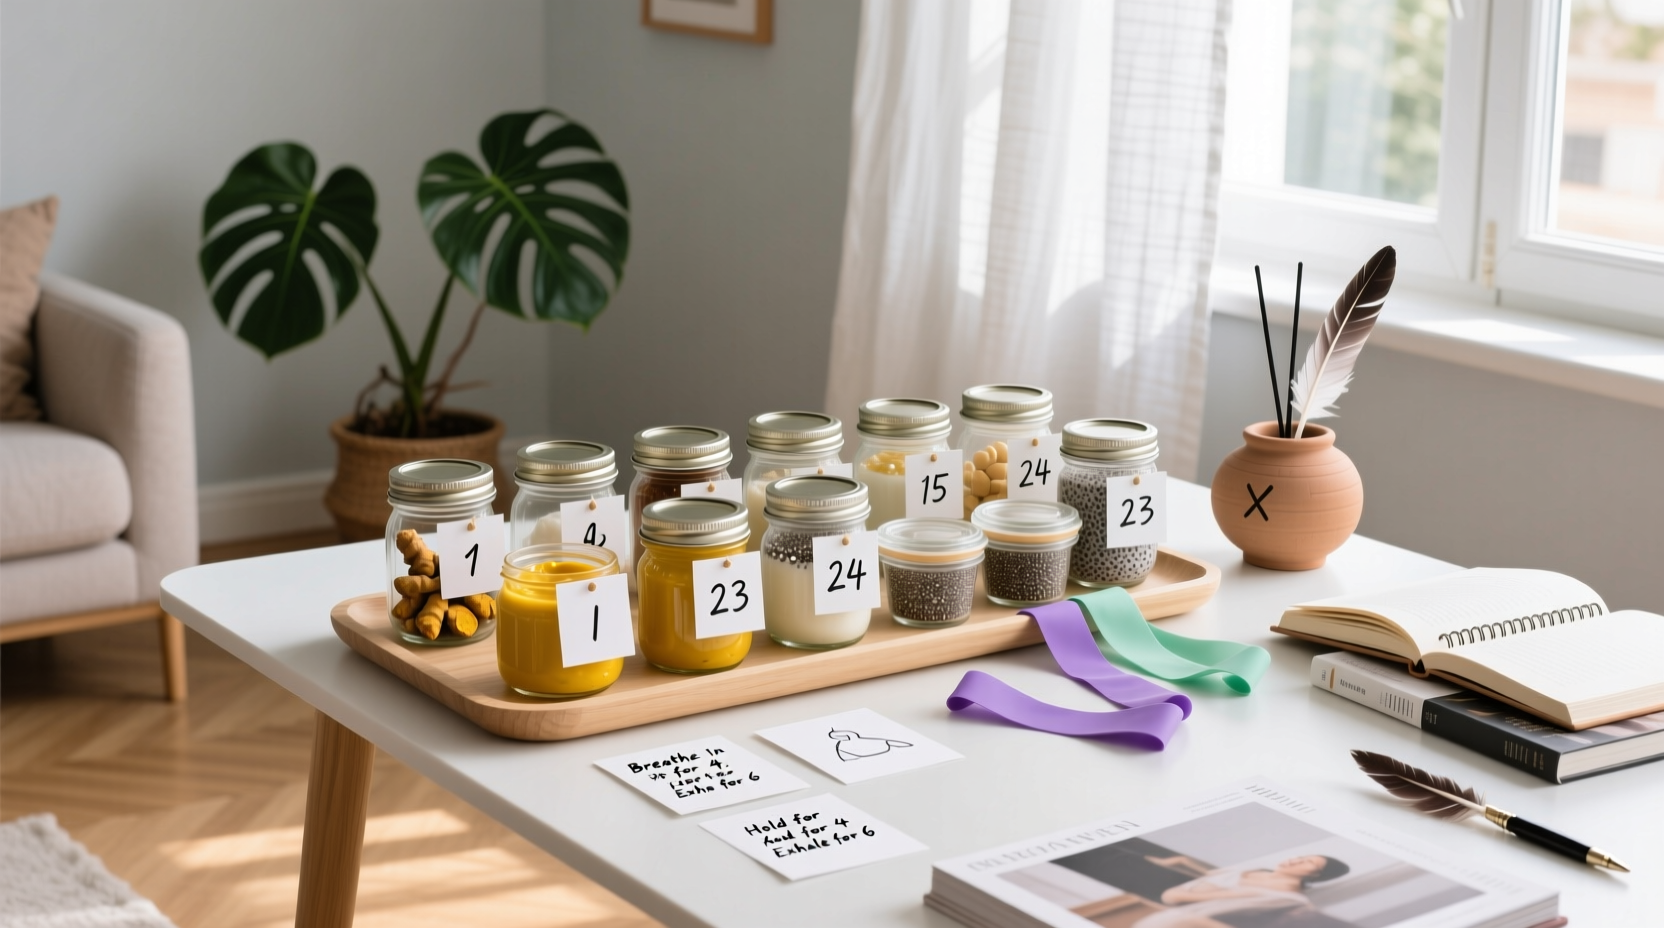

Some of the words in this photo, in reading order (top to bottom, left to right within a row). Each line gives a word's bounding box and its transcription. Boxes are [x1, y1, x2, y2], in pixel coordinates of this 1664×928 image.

[921, 472, 949, 505] 15
[1019, 457, 1051, 488] 24
[1119, 495, 1154, 528] 23
[1243, 483, 1274, 522] X
[464, 543, 479, 577] 1
[827, 558, 867, 593] 24
[710, 579, 749, 616] 23
[673, 766, 699, 778] for
[720, 779, 743, 790] for
[749, 771, 760, 782] 6
[744, 817, 788, 837] Hold
[792, 812, 820, 825] for
[801, 825, 828, 838] for
[834, 818, 850, 828] 4
[772, 838, 831, 858] Exhale
[834, 832, 858, 846] for
[862, 825, 875, 837] 6
